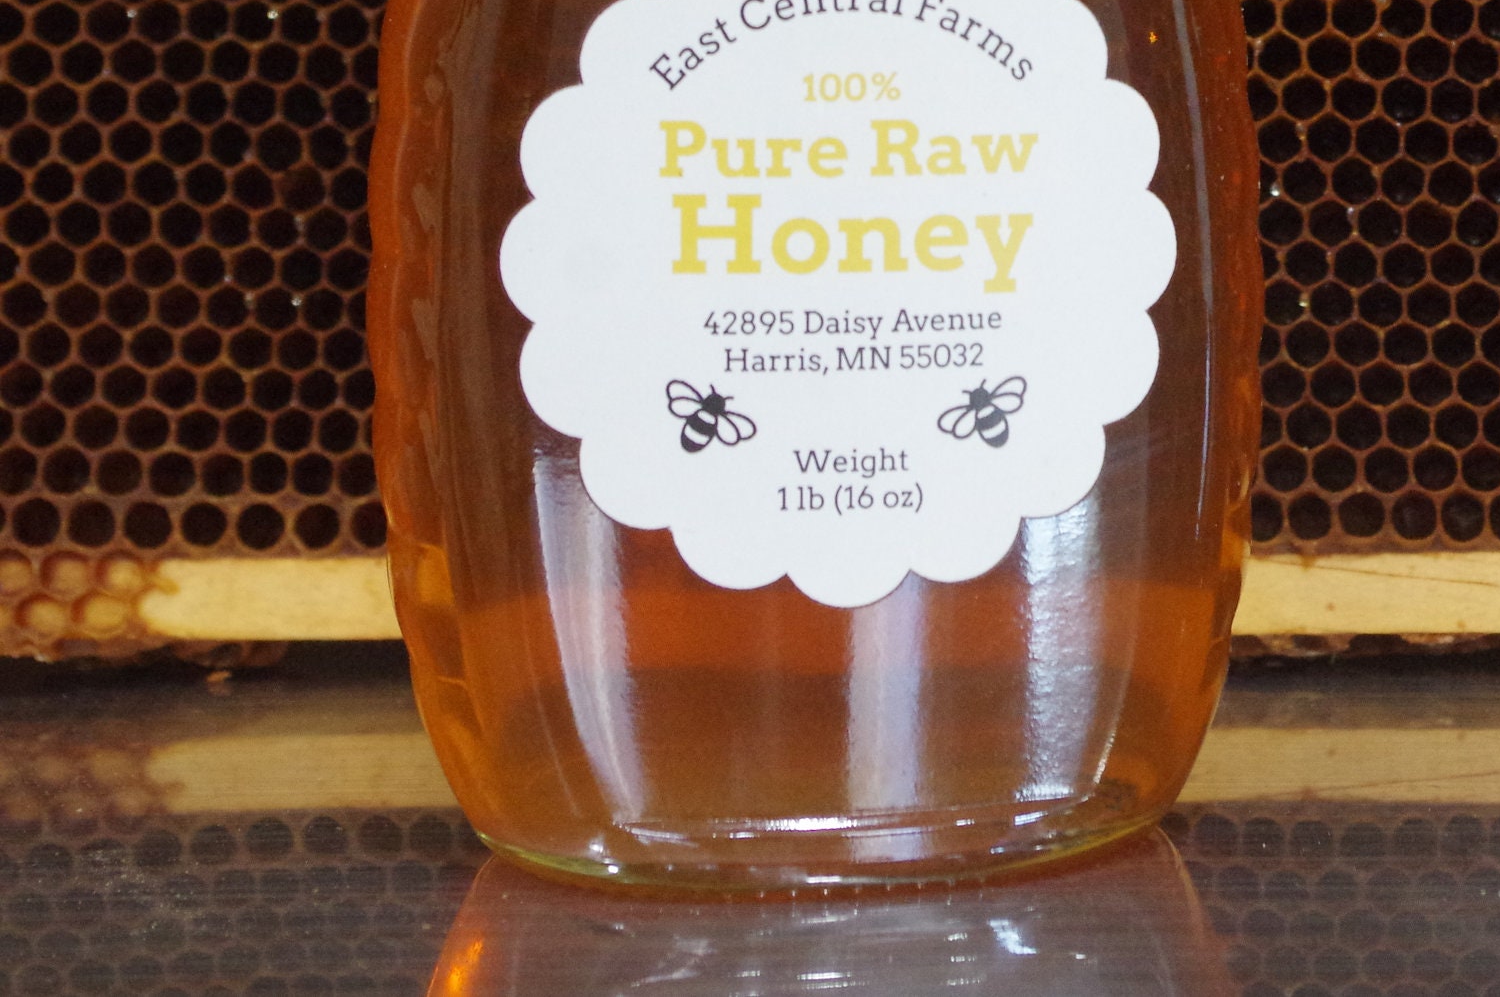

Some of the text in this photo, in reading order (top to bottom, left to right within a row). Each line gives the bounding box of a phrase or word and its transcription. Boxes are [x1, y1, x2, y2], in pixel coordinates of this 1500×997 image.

[649, 18, 737, 91] East
[803, 72, 901, 102] 100%
[659, 119, 1038, 178] Pure Raw
[672, 194, 1033, 293] Honey
[703, 308, 1002, 340] 42895 Daisy Avenue
[724, 342, 983, 375] Harris, MN 55032
[793, 447, 908, 479] Weight
